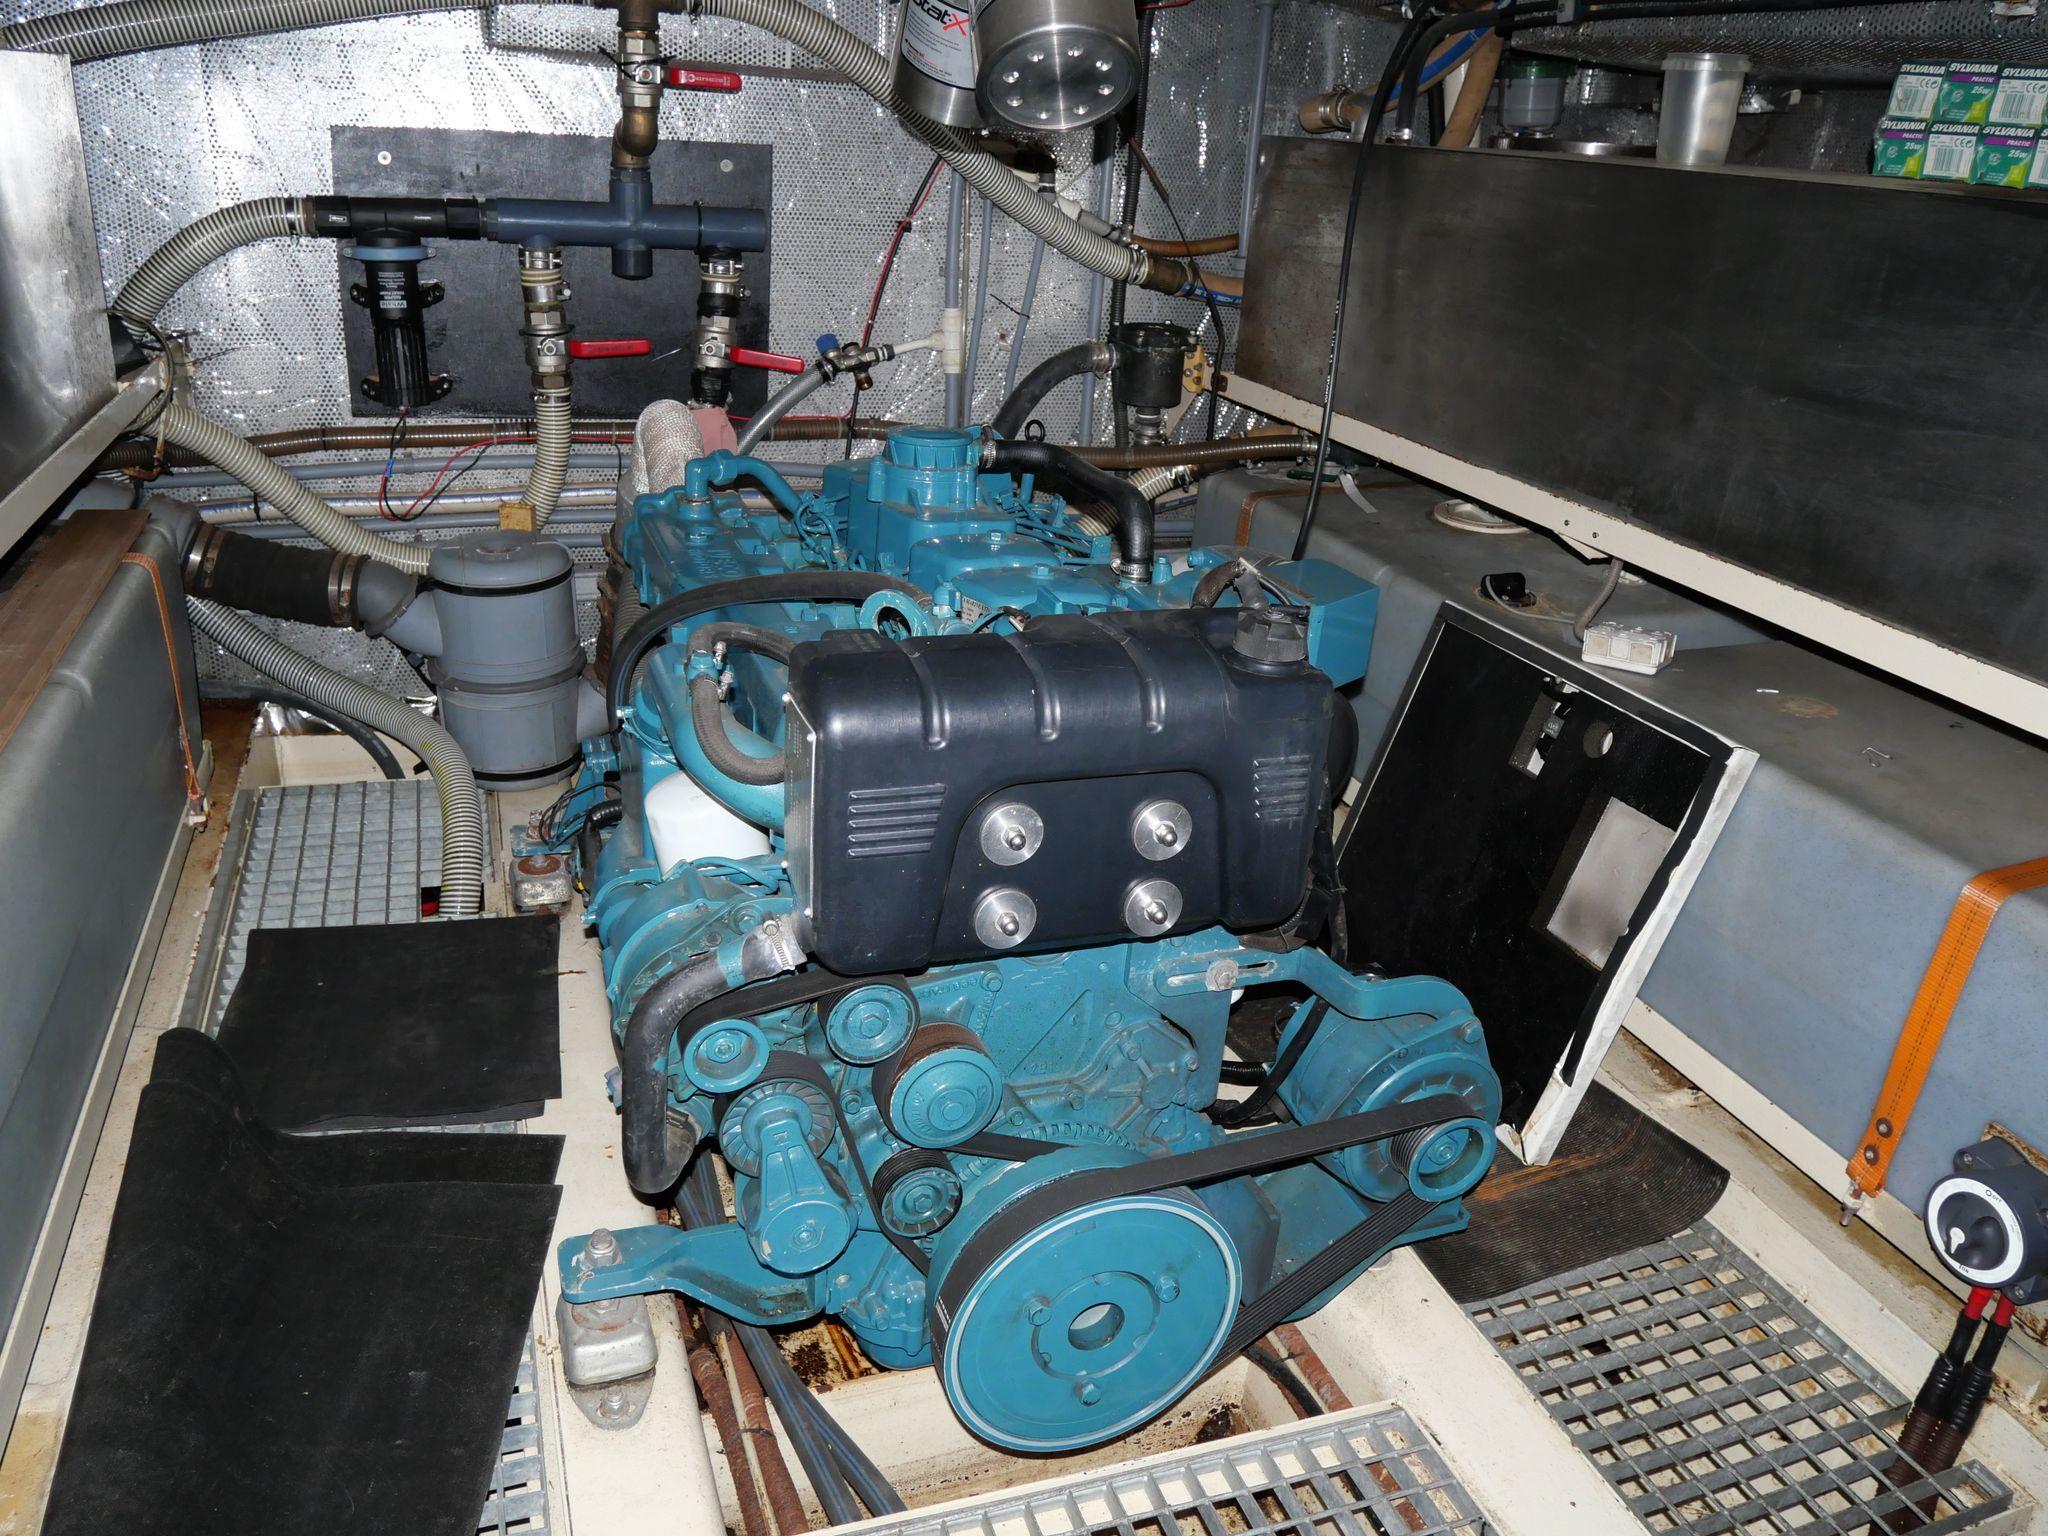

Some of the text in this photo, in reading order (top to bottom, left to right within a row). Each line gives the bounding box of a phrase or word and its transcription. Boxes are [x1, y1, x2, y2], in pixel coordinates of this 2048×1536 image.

[1900, 63, 1946, 75] SYLVANIA
[1948, 62, 1999, 74] SYLVANIA
[1881, 120, 1927, 131] SYLVANIA
[1931, 123, 1980, 135] SYLVANIA
[1982, 126, 2035, 138] SYLVANIA
[2006, 139, 2031, 147] PRACTIC
[1992, 1195, 2002, 1203] OFF
